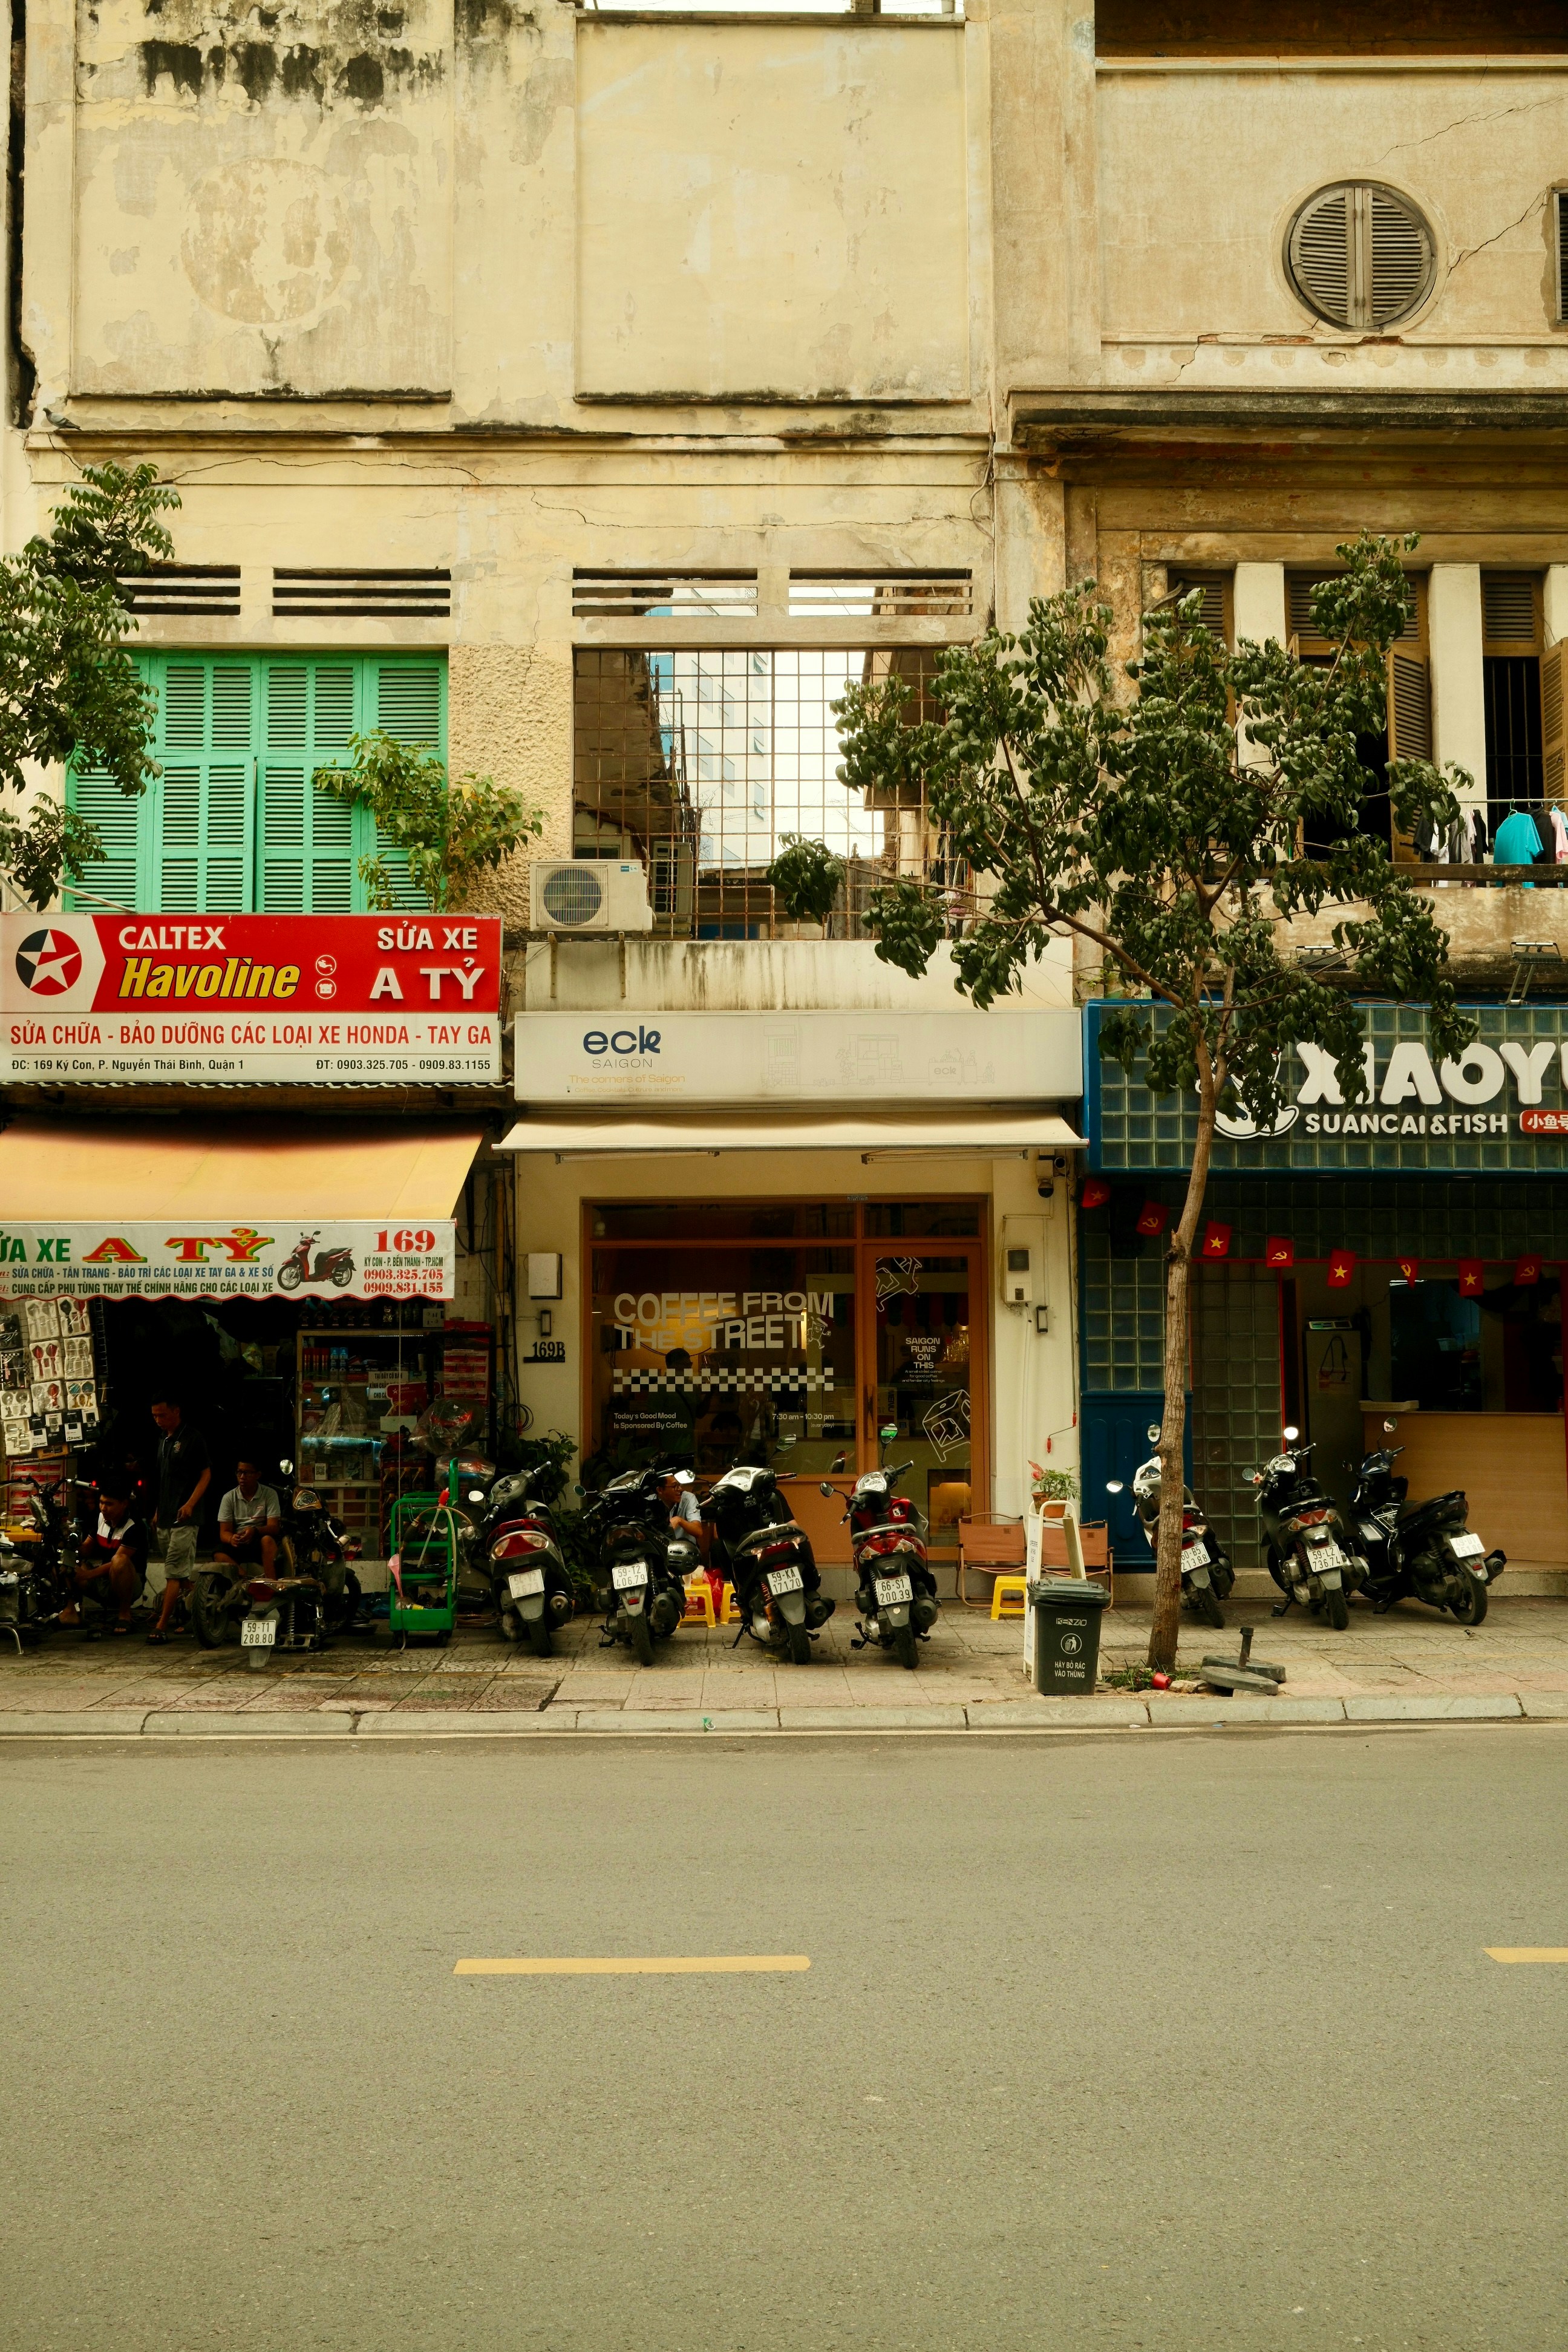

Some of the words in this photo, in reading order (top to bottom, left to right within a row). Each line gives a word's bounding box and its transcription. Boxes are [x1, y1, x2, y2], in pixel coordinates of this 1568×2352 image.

[119, 926, 226, 950] CALTEX
[377, 920, 434, 950] SỬA
[442, 928, 477, 949] XE
[117, 956, 301, 999] Havoline
[370, 968, 403, 999] A
[420, 957, 485, 999] TỶ
[10, 1019, 47, 1045] SỬA
[53, 1021, 102, 1045] CHỮA
[120, 1019, 155, 1045] BẢO
[162, 1021, 224, 1045] DƯỠNG
[232, 1021, 266, 1045] CÁC
[273, 1025, 312, 1048] LOẠI
[318, 1025, 341, 1044] XE
[347, 1025, 410, 1044] HONDA
[428, 1025, 461, 1044] TAY
[468, 1025, 491, 1044] GA
[583, 1025, 661, 1055] eck
[12, 1060, 30, 1070] ĐC:
[33, 1060, 53, 1070] 169
[56, 1059, 68, 1071] Ký
[72, 1060, 94, 1071] Con,
[99, 1060, 108, 1070] P.
[112, 1058, 151, 1071] Nguyễn
[154, 1059, 175, 1070] Thái
[179, 1059, 204, 1071] Bình,
[208, 1060, 235, 1071] Quận
[238, 1060, 243, 1069] 1
[316, 1060, 333, 1070] ĐT:
[337, 1060, 408, 1070] 0903.325.705
[419, 1060, 491, 1070] 0909.83.1155
[592, 1058, 652, 1068] SAIGON
[933, 1066, 956, 1075] eck
[1296, 1042, 1568, 1105] XIAOY
[569, 1075, 589, 1083] The
[635, 1074, 646, 1083] of
[648, 1074, 685, 1085] Saigon
[1305, 1113, 1508, 1135] SUANCAI&FISH
[36, 1238, 71, 1263] XE
[82, 1237, 148, 1263] A
[164, 1228, 275, 1263] TỶ
[373, 1229, 436, 1253] 169
[364, 1255, 371, 1267] KÝ
[372, 1256, 382, 1267] CON
[387, 1256, 391, 1267] P.
[393, 1254, 403, 1267] BẾN
[404, 1255, 420, 1267] THÀNH
[425, 1256, 443, 1267] TP.HCM
[12, 1265, 29, 1278] SỬA
[32, 1266, 54, 1278] CHỮA
[63, 1266, 79, 1278] TÂN
[82, 1268, 109, 1278] TRANG
[118, 1265, 136, 1278] BẢO
[138, 1266, 151, 1278] TRÌ
[154, 1266, 171, 1278] CÁC
[174, 1267, 192, 1279] LOẠI
[195, 1267, 205, 1277] XE
[209, 1267, 222, 1277] TAY
[225, 1267, 235, 1277] GA
[239, 1267, 245, 1277] &
[249, 1267, 258, 1277] XE
[262, 1264, 273, 1277] SỐ
[364, 1269, 443, 1280] 0903.325.705
[12, 1283, 35, 1293] CUNG
[38, 1279, 55, 1293] CẤP
[58, 1283, 75, 1295] PHỤ
[78, 1281, 100, 1293] TÙNG
[103, 1283, 125, 1293] THAY
[126, 1279, 142, 1293] THẾ
[145, 1281, 171, 1293] CHÍNH
[174, 1281, 197, 1292] HÃNG
[200, 1282, 217, 1293] CHO
[220, 1281, 237, 1292] CÁC
[240, 1282, 260, 1294] LOẠI
[262, 1282, 273, 1292] XE
[364, 1282, 443, 1293] 0909.831.155
[614, 1292, 736, 1327] COFFEE
[743, 1292, 834, 1318] FROM
[614, 1322, 676, 1349] THE
[683, 1313, 805, 1349] STREET
[532, 1341, 566, 1357] 169B
[1312, 1547, 1335, 1560] 59-L2
[1313, 1556, 1341, 1570] 736.74
[618, 1565, 641, 1577] 59-T2
[771, 1568, 795, 1583] 59-KA
[616, 1574, 645, 1587] 406.79
[773, 1578, 801, 1593] 171.70
[881, 1579, 904, 1591] 66-S1
[515, 1582, 539, 1596] 2673
[880, 1589, 910, 1603] 200.39
[247, 1622, 270, 1633] 59-T1
[243, 1634, 273, 1644] 288.80
[1066, 1660, 1074, 1668] BỎ
[1074, 1661, 1085, 1670] RÁC
[1054, 1669, 1065, 1677] VÀO
[1067, 1670, 1085, 1678] THÙNG
